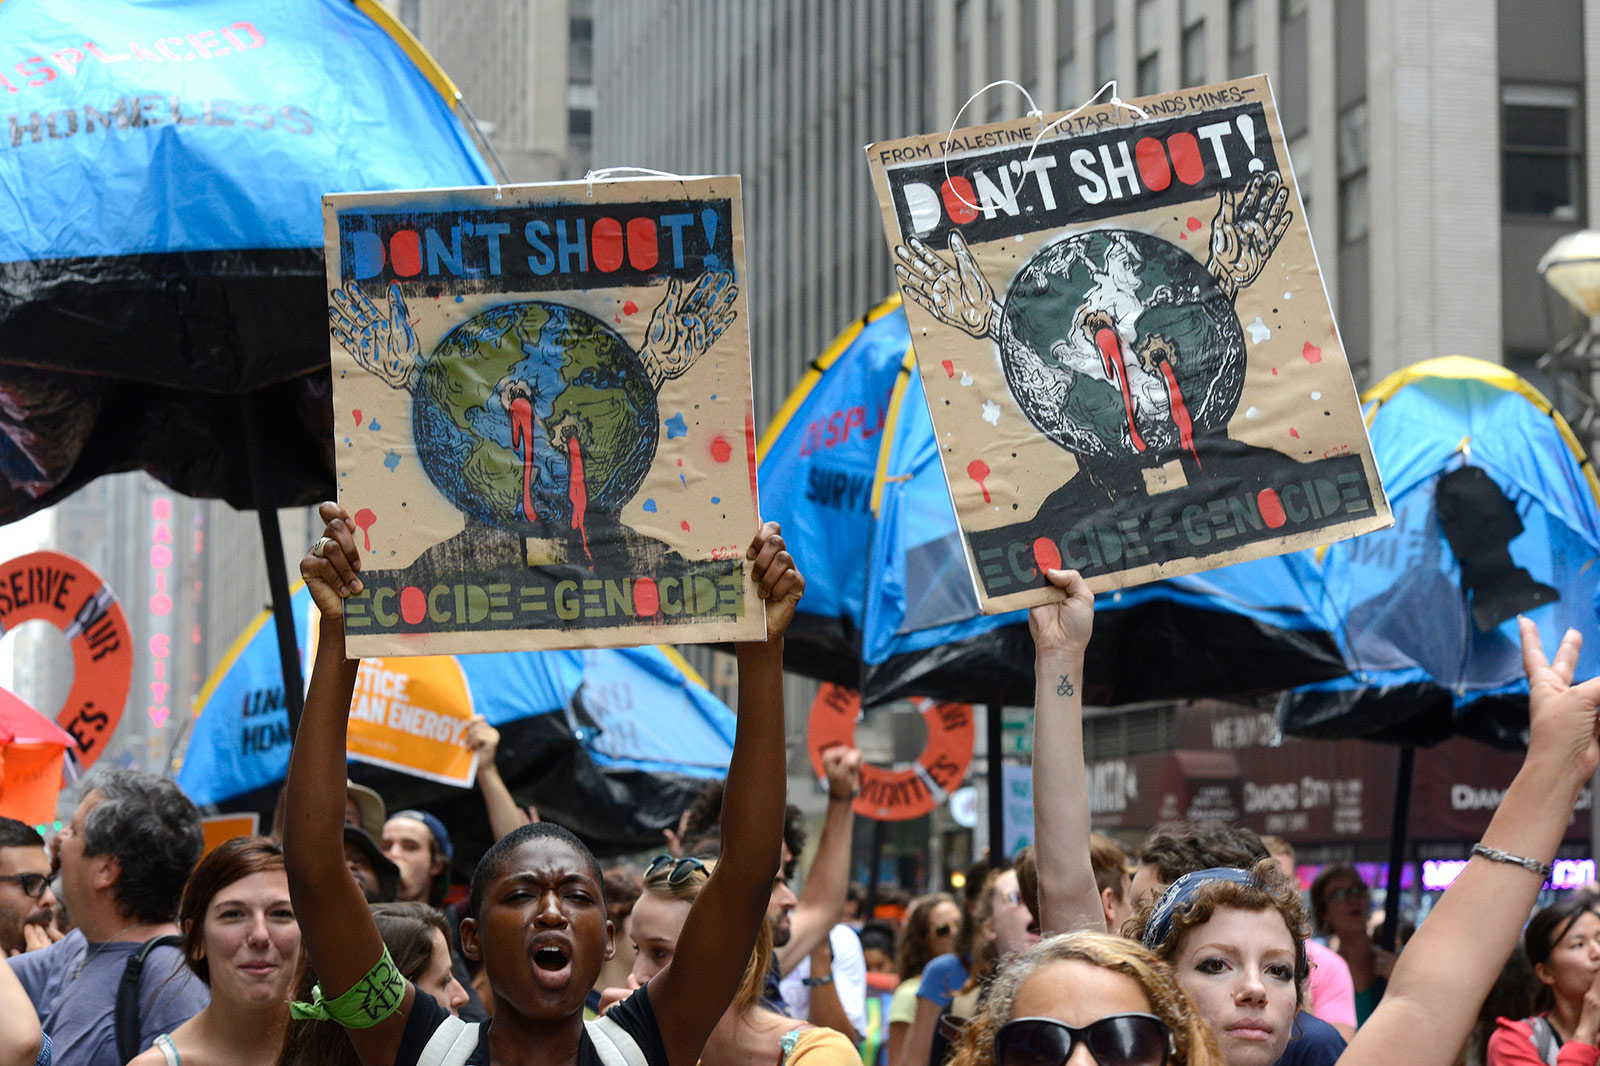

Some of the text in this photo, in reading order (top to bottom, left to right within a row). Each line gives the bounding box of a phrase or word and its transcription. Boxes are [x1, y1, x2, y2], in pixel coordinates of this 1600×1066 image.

[8, 95, 314, 148] HOMELESS
[879, 146, 932, 166] FROM
[941, 127, 1032, 155] PALESTINE
[1072, 114, 1116, 134] TAR
[1128, 97, 1187, 119] SANDS
[903, 113, 1265, 234] DON'T SHOOT!
[353, 207, 720, 281] DON'T SHOOT!
[148, 633, 170, 729] CITY
